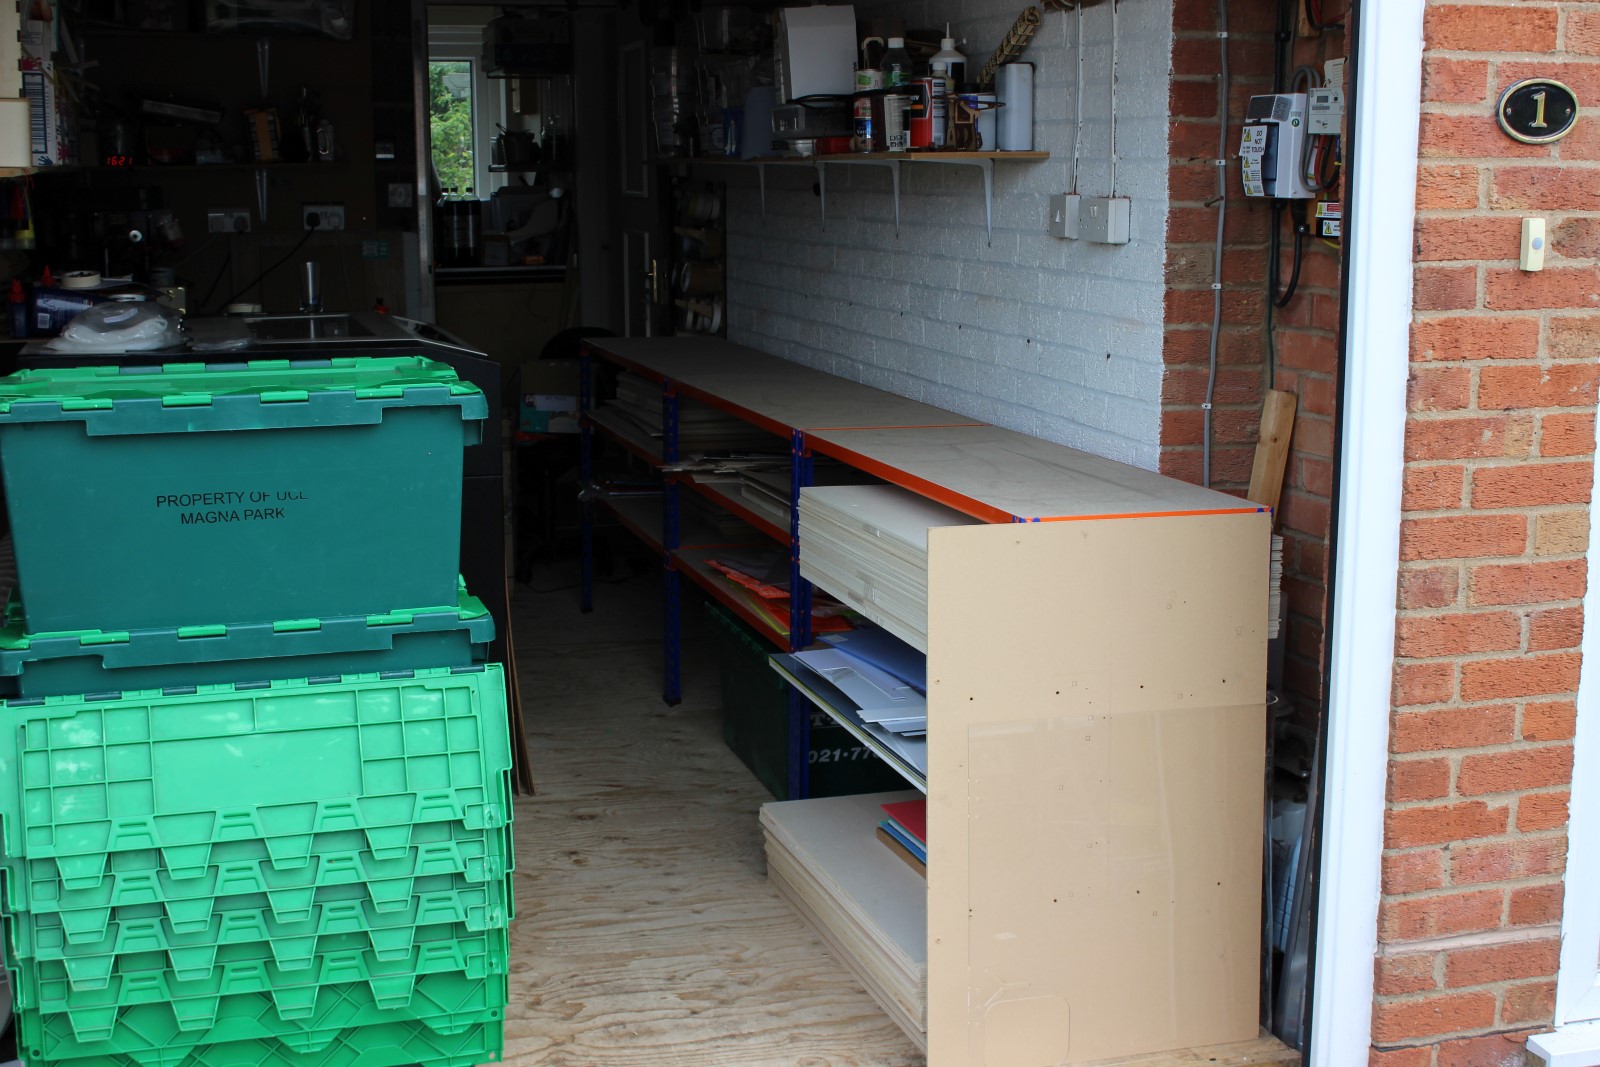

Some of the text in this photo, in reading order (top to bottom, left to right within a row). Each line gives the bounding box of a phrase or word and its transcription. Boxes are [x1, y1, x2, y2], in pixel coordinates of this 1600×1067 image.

[1528, 91, 1548, 128] 1
[107, 156, 133, 166] 1621
[156, 491, 245, 508] PROPERTY
[249, 491, 270, 503] OF
[180, 507, 286, 525] MAGNA PARK
